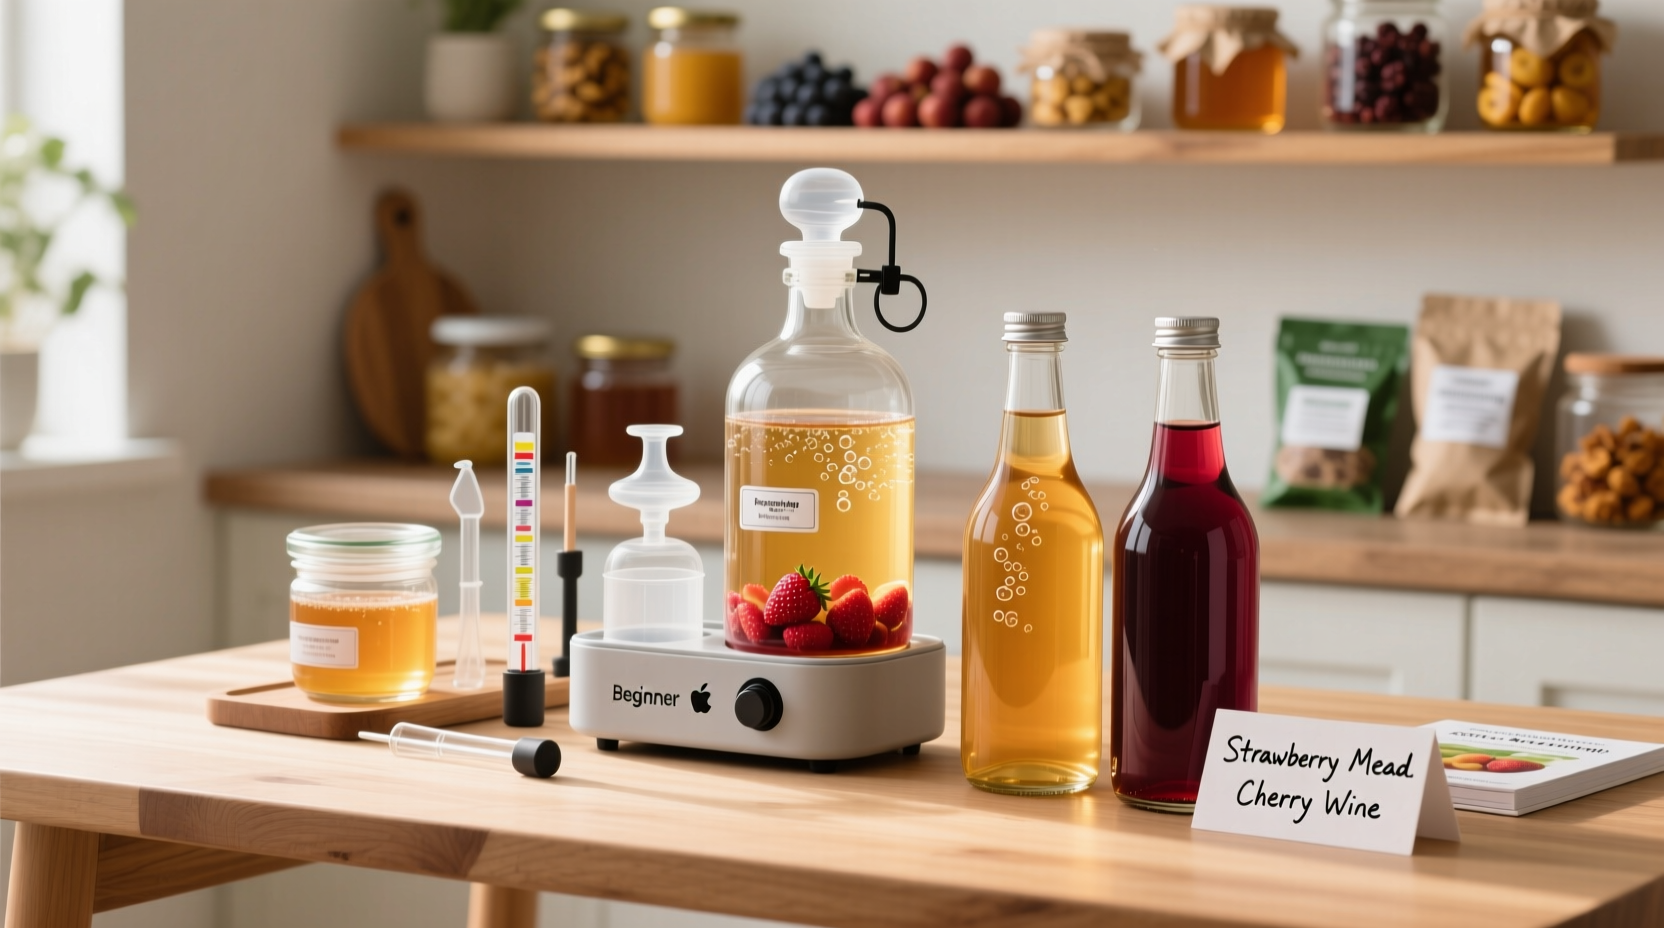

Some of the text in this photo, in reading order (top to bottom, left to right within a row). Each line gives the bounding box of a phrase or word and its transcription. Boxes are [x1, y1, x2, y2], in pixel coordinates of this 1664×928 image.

[1223, 734, 1414, 783] Strawberry Mead
[1236, 779, 1381, 825] Cherry Wine
